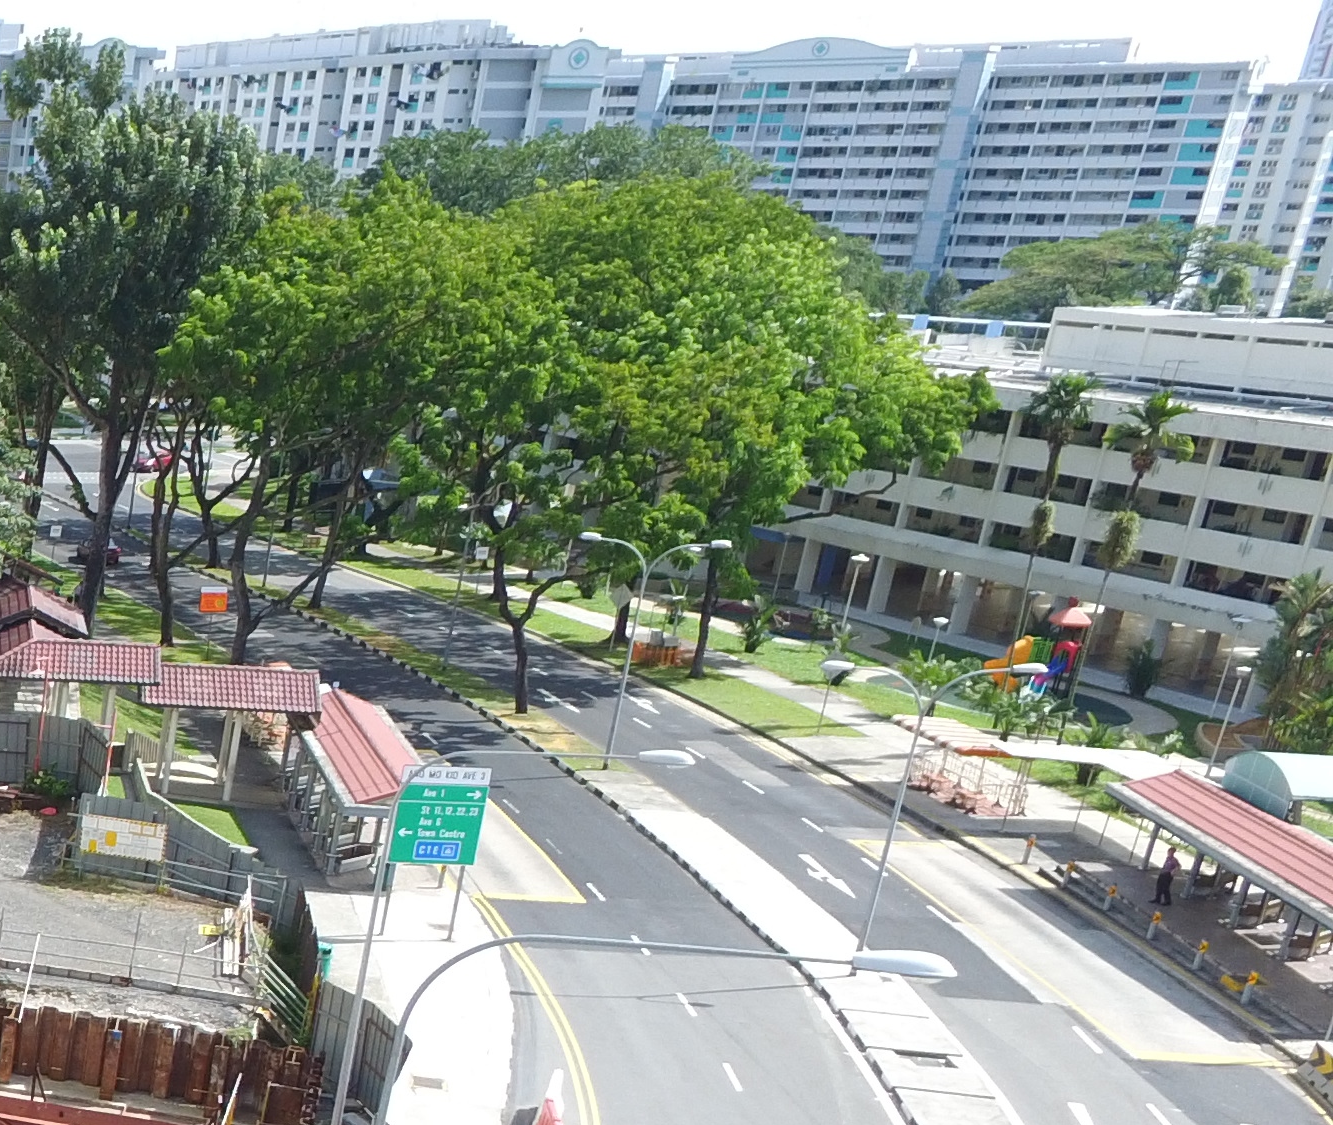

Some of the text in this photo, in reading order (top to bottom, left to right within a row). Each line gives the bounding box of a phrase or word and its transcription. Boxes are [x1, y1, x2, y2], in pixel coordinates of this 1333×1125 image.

[462, 771, 477, 780] AVE
[423, 788, 437, 797] Ave
[421, 806, 431, 815] St
[419, 817, 433, 826] Ave
[417, 828, 466, 838] Town Centre
[419, 845, 439, 855] CTE
